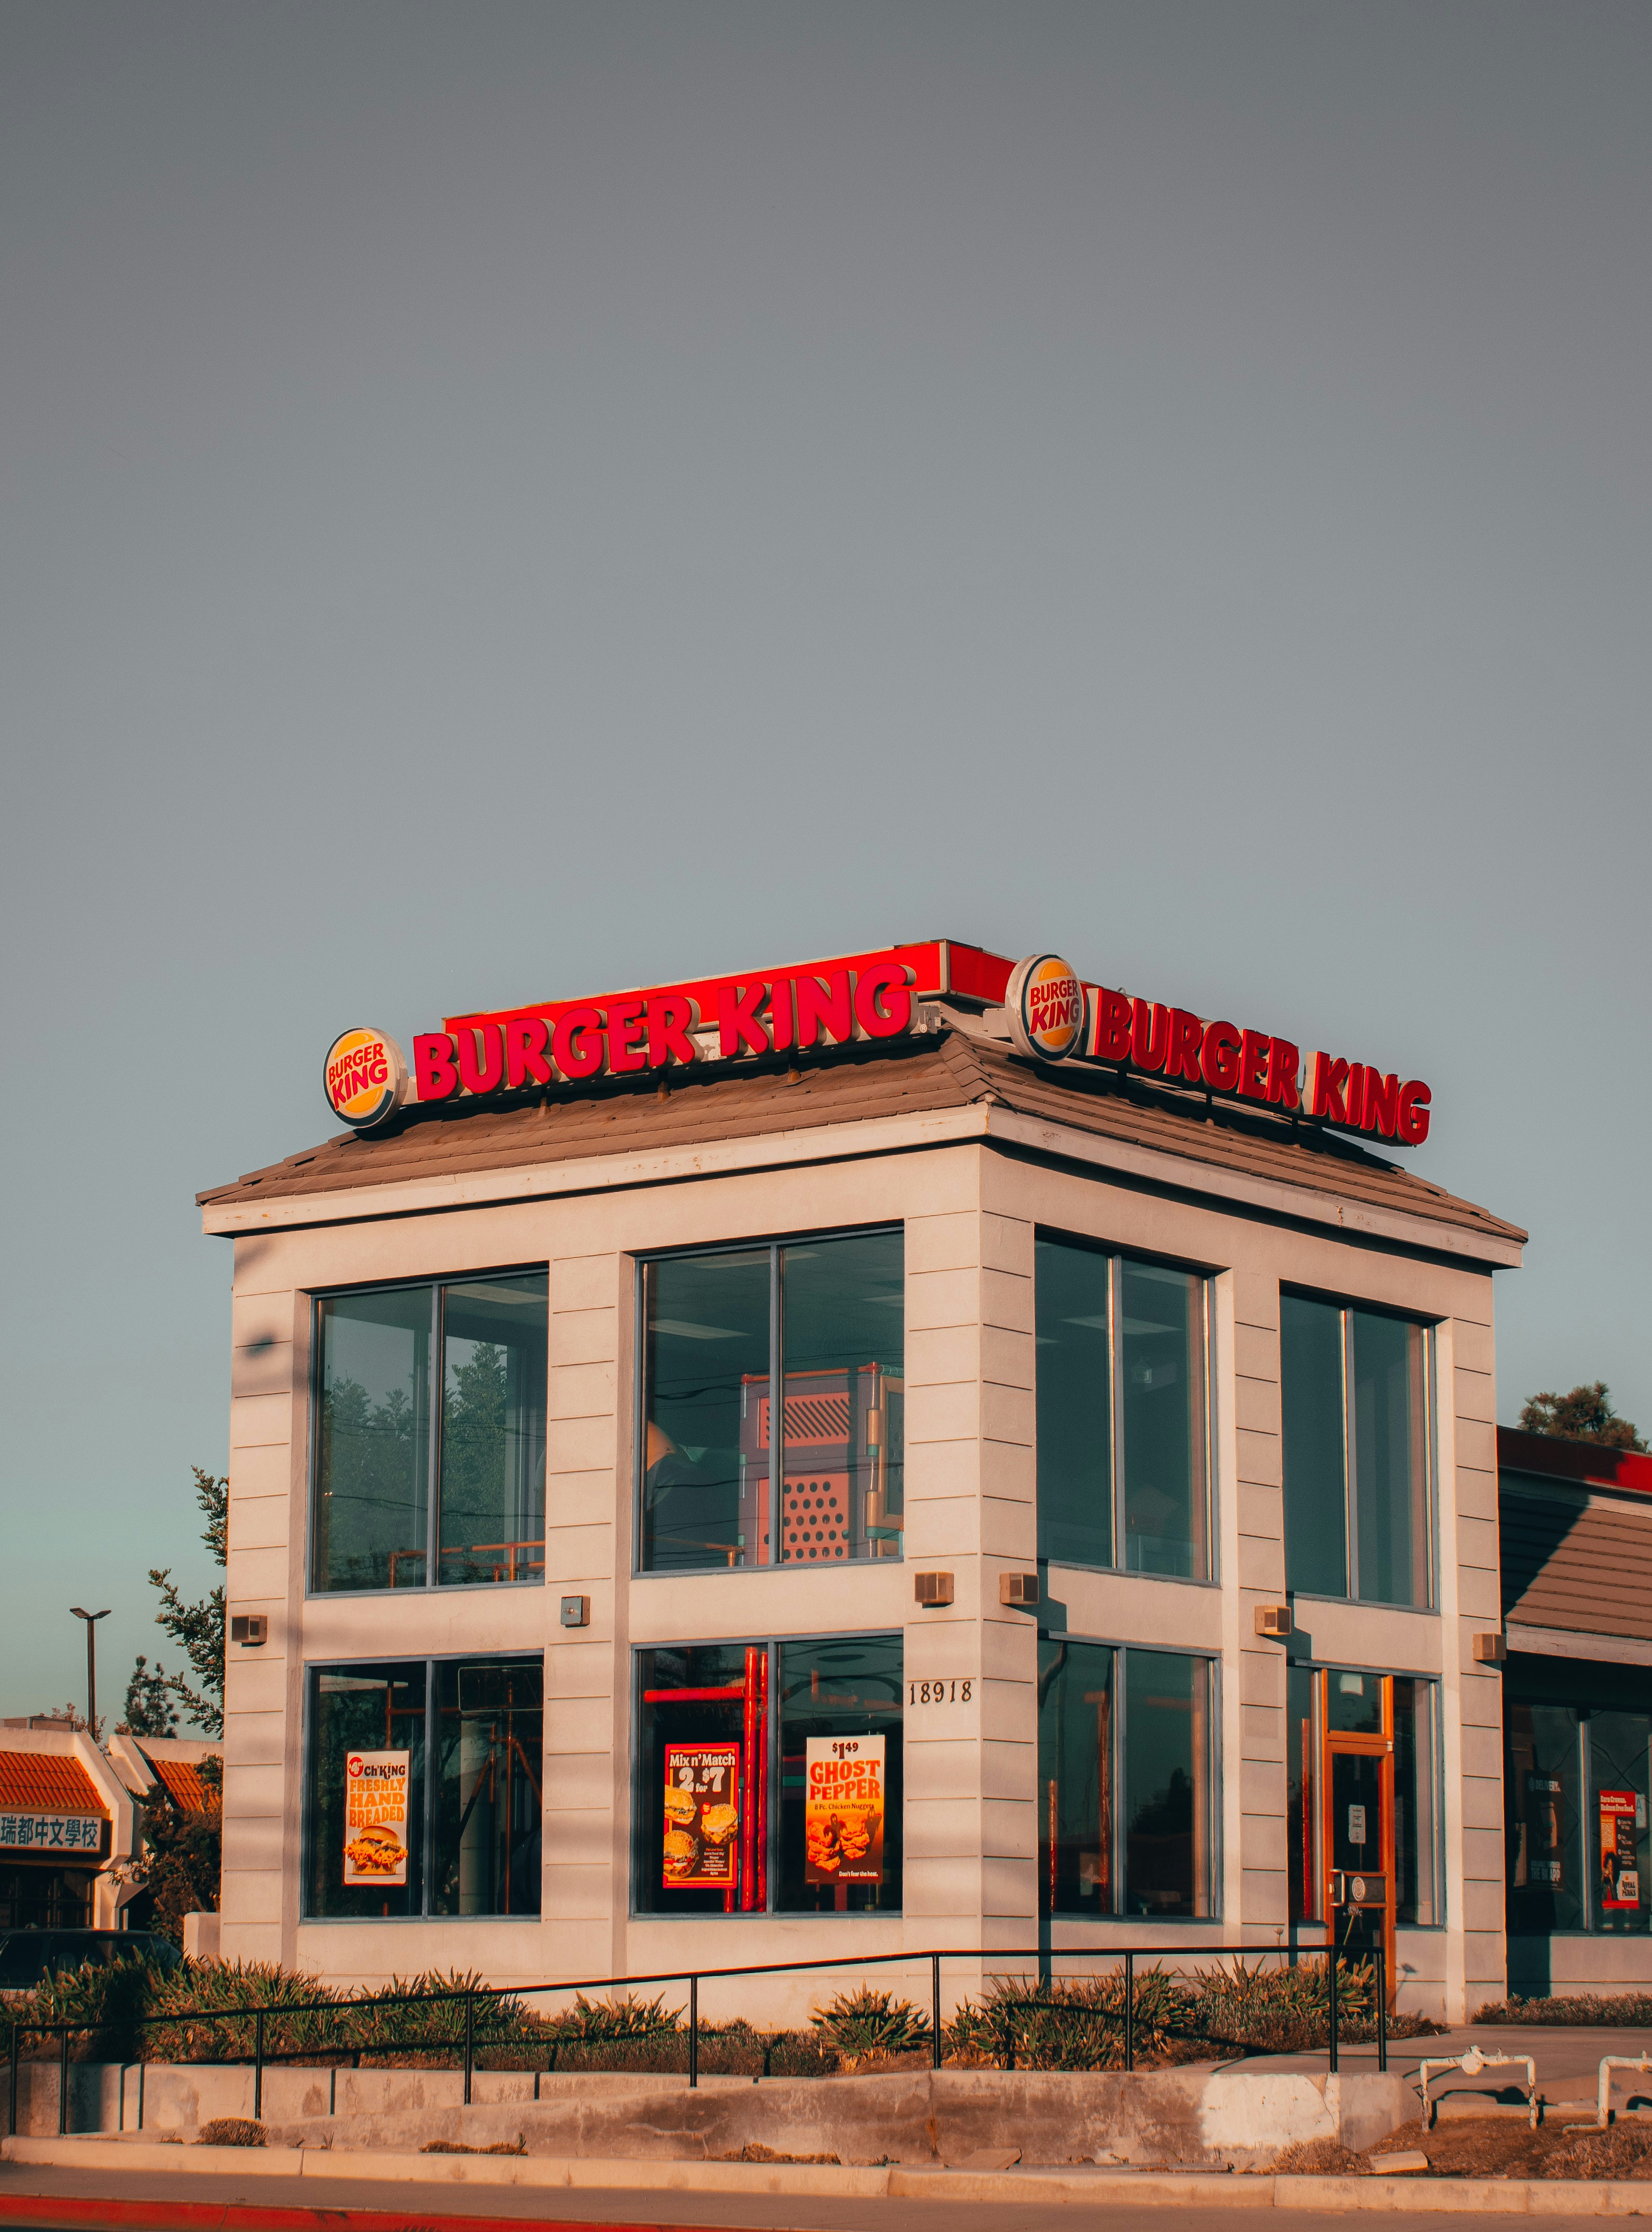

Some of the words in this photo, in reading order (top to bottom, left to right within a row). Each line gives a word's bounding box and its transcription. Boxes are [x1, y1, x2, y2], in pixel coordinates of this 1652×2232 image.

[1030, 979, 1079, 1008] BURGER
[1029, 999, 1079, 1037] KING
[413, 996, 697, 1100] BURGER
[718, 963, 912, 1057] KING
[328, 1043, 384, 1086] BURGER
[1093, 987, 1300, 1109] BURGER
[1311, 1051, 1432, 1145] KING
[332, 1059, 388, 1112] KING
[910, 1680, 972, 1705] 18918
[669, 1754, 690, 1767] Mix
[701, 1753, 736, 1767] Match
[832, 1742, 859, 1759] $149
[350, 1777, 406, 1792] FRESHLY
[679, 1767, 694, 1793] 2
[695, 1782, 708, 1793] for
[702, 1767, 725, 1793] $7
[809, 1760, 881, 1785] GHOST
[350, 1792, 405, 1808] HAND
[809, 1778, 880, 1801] PEPPER
[349, 1806, 405, 1828] BREADED
[0, 1815, 98, 1848] 瑞都中文學校
